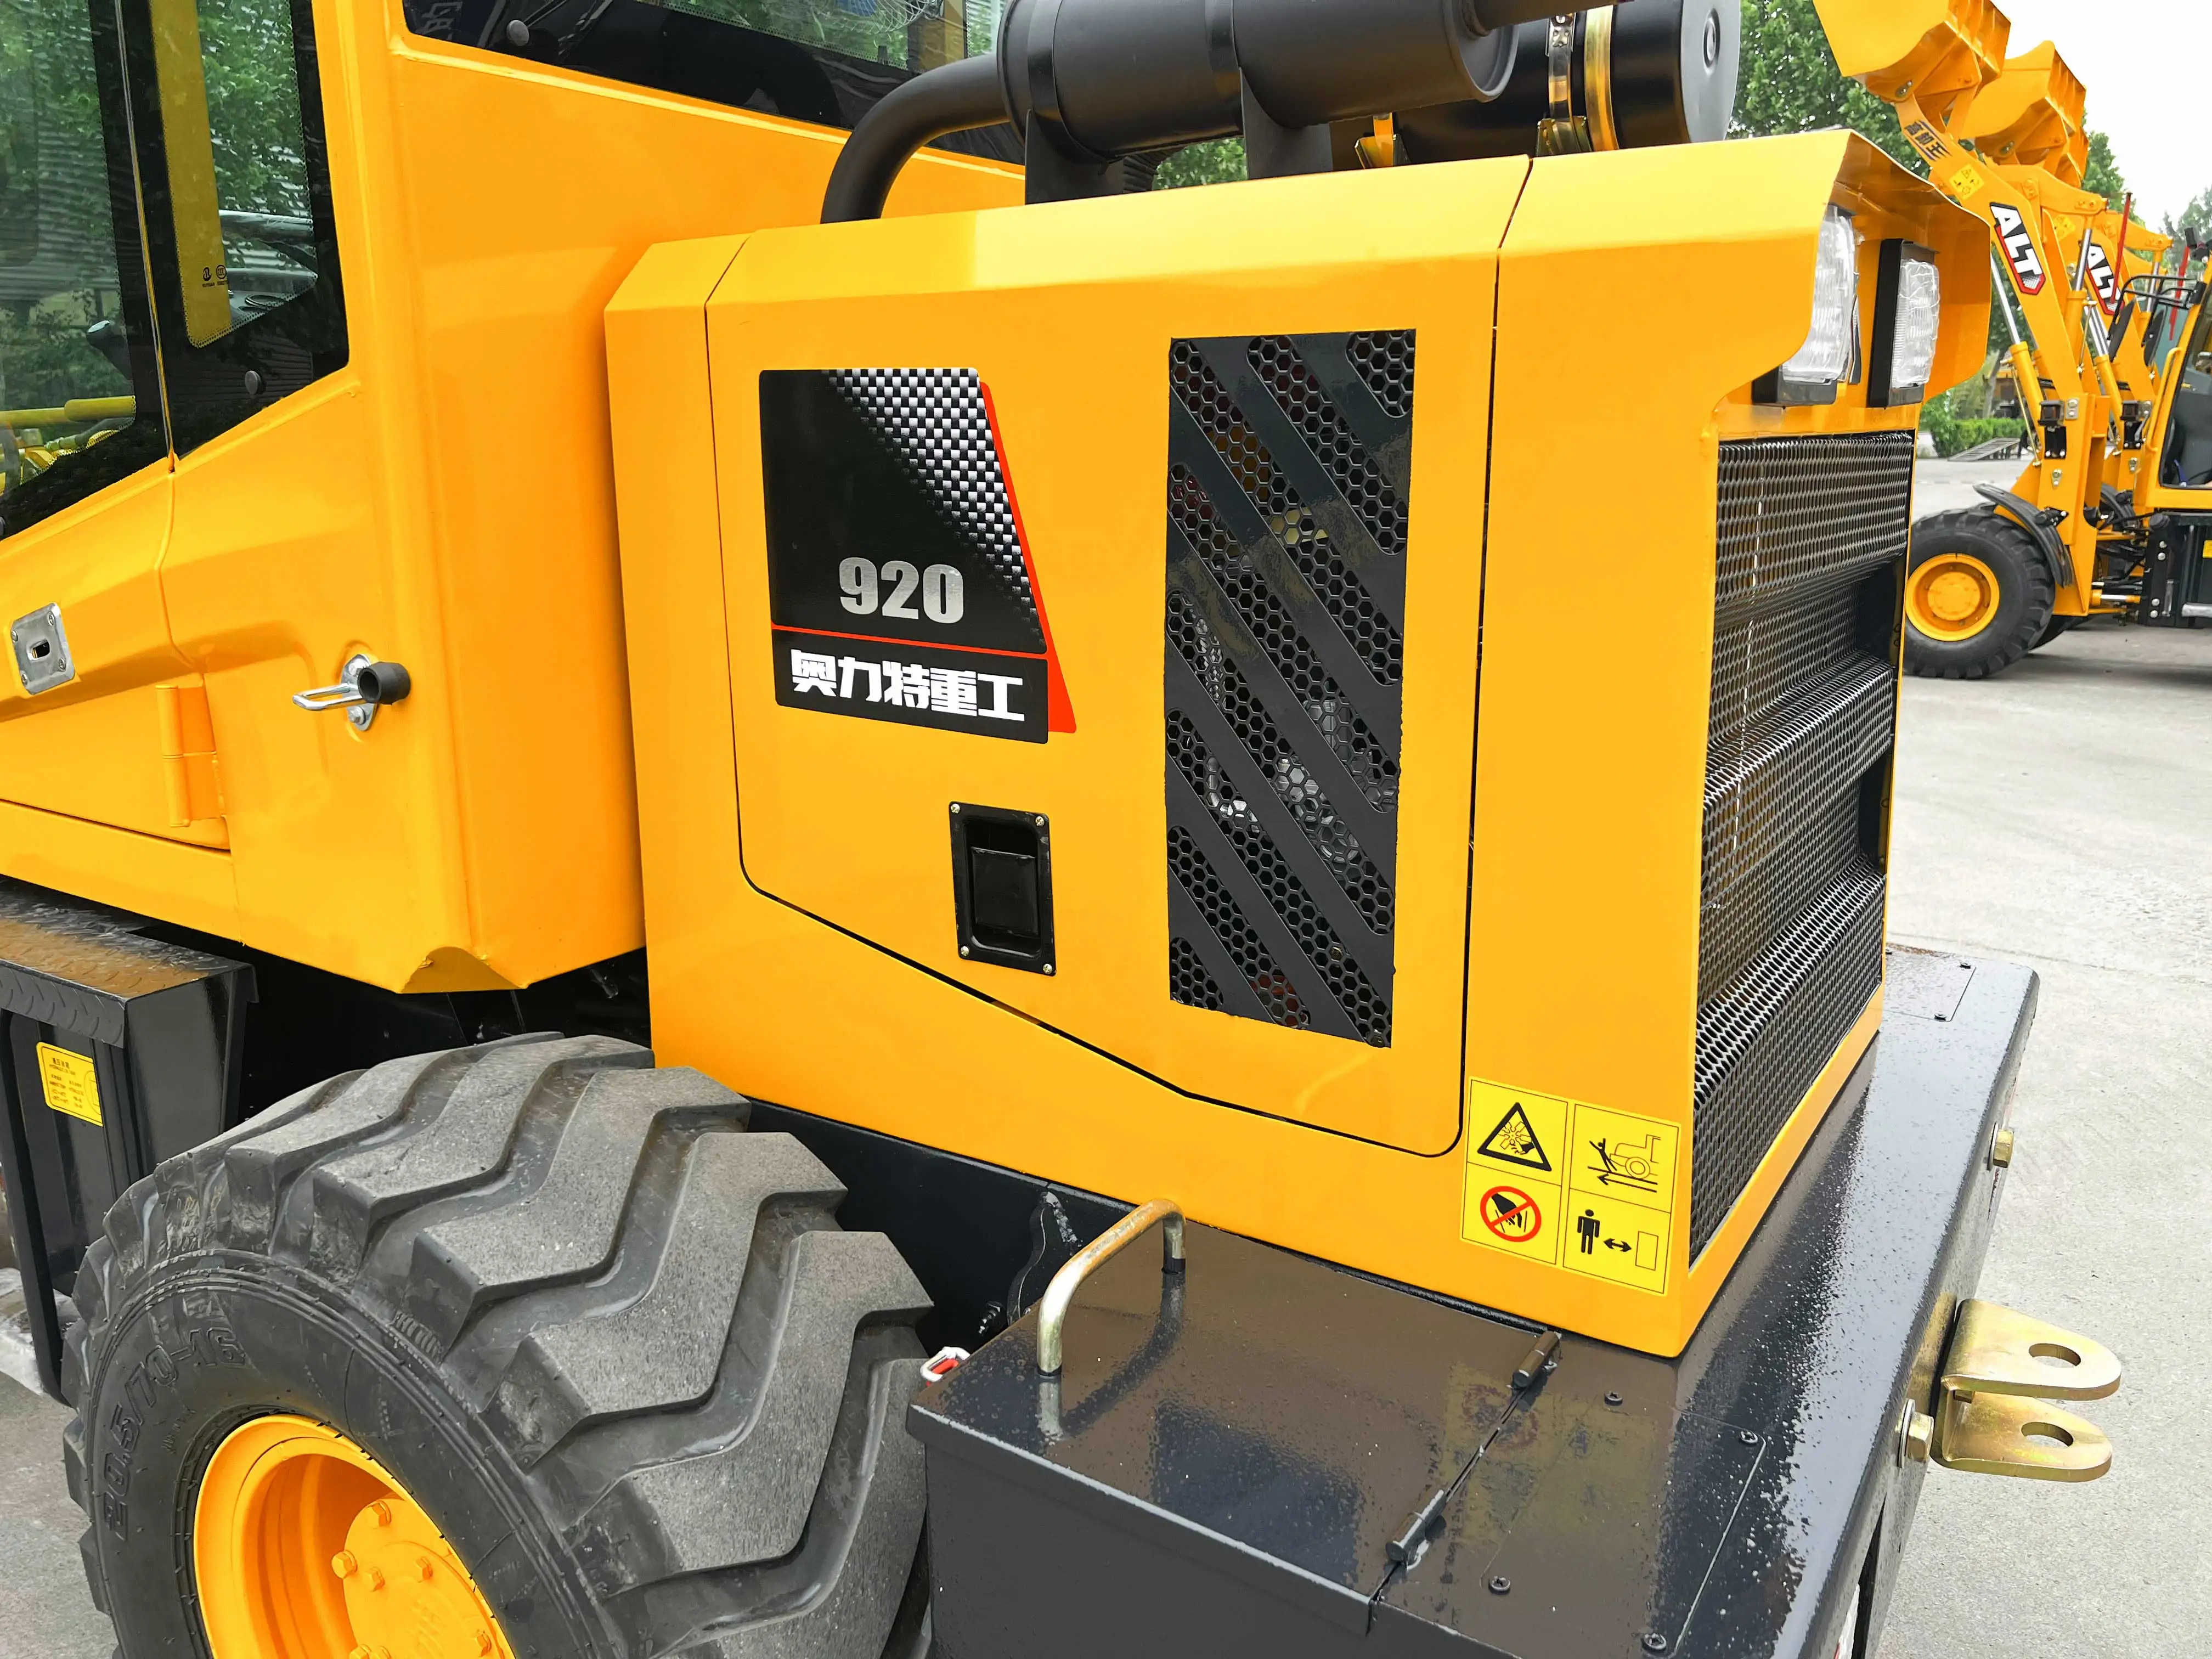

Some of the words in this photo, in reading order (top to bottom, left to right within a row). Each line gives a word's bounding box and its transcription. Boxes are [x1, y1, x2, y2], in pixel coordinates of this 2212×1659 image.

[1990, 206, 2042, 275] ALT
[839, 557, 963, 623] 920
[791, 649, 1025, 721] 奥力特重工
